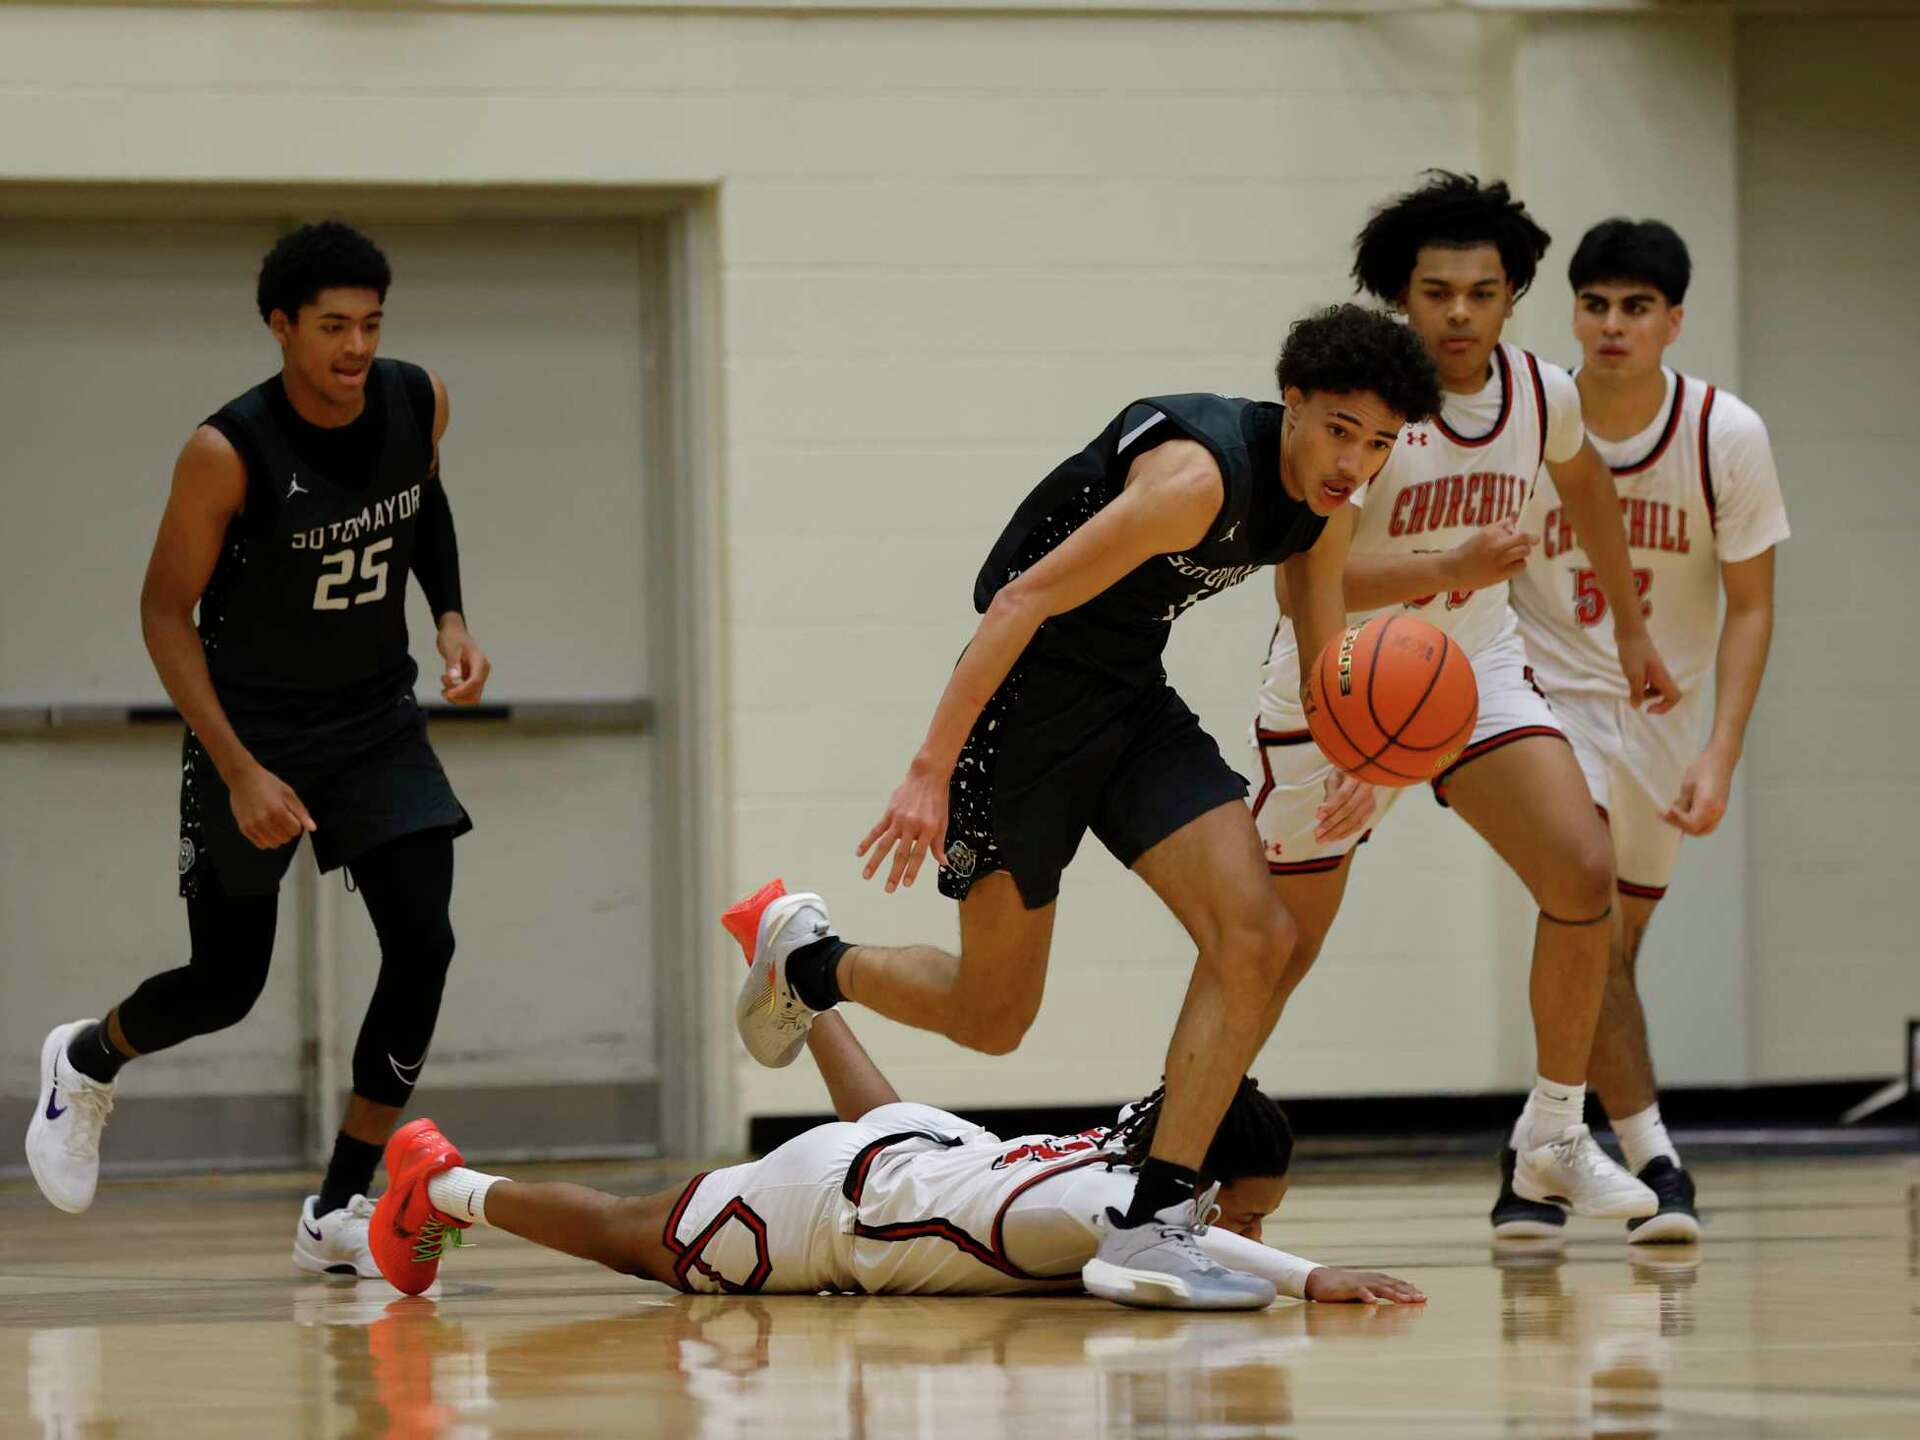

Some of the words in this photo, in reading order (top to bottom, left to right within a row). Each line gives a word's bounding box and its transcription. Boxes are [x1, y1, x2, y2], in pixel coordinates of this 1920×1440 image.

[291, 484, 421, 550] SOTOMAYOR
[1388, 472, 1527, 537] CHURCHILL
[1544, 497, 1691, 558] CHHILL
[312, 536, 394, 611] 25
